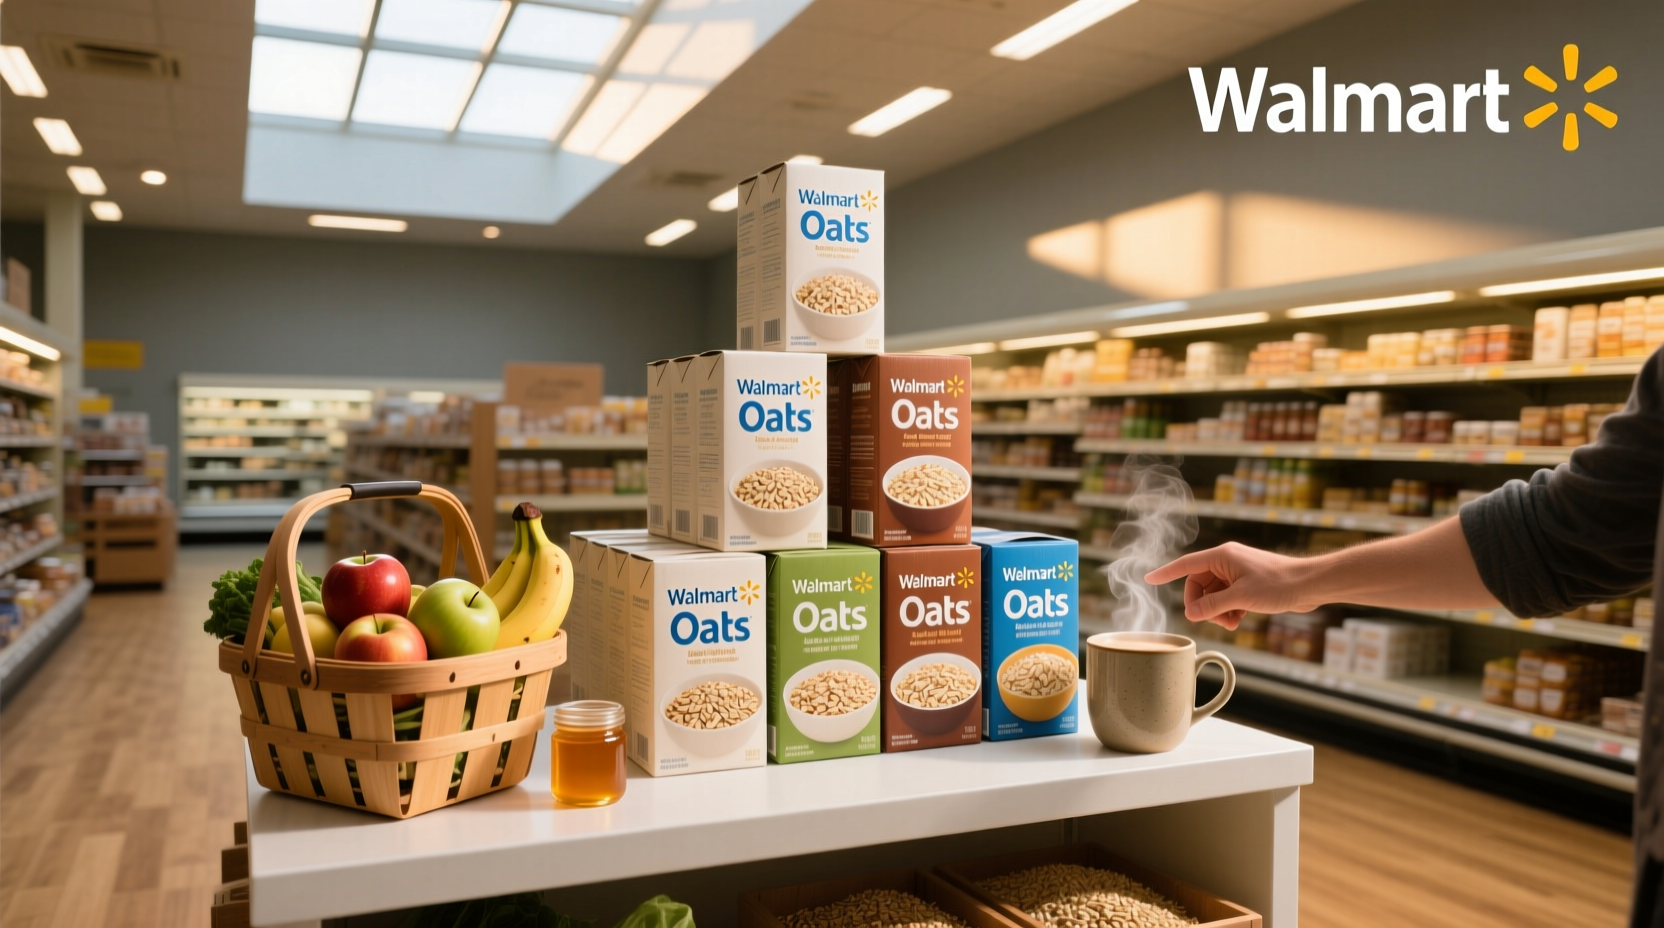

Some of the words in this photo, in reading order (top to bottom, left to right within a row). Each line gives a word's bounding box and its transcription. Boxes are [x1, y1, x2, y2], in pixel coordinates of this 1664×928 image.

[798, 189, 859, 208] Walmart
[800, 210, 870, 243] Oats
[737, 379, 801, 395] Walmart
[890, 378, 945, 394] Walmart
[738, 400, 812, 433] Oats
[891, 398, 959, 430] Oats
[792, 577, 853, 594] Walmart
[899, 572, 956, 589] Walmart
[667, 586, 738, 606] Walmart
[1003, 589, 1069, 619] Oats
[793, 601, 868, 633] Oats
[900, 595, 971, 628] Oats
[670, 611, 750, 645] Oats
